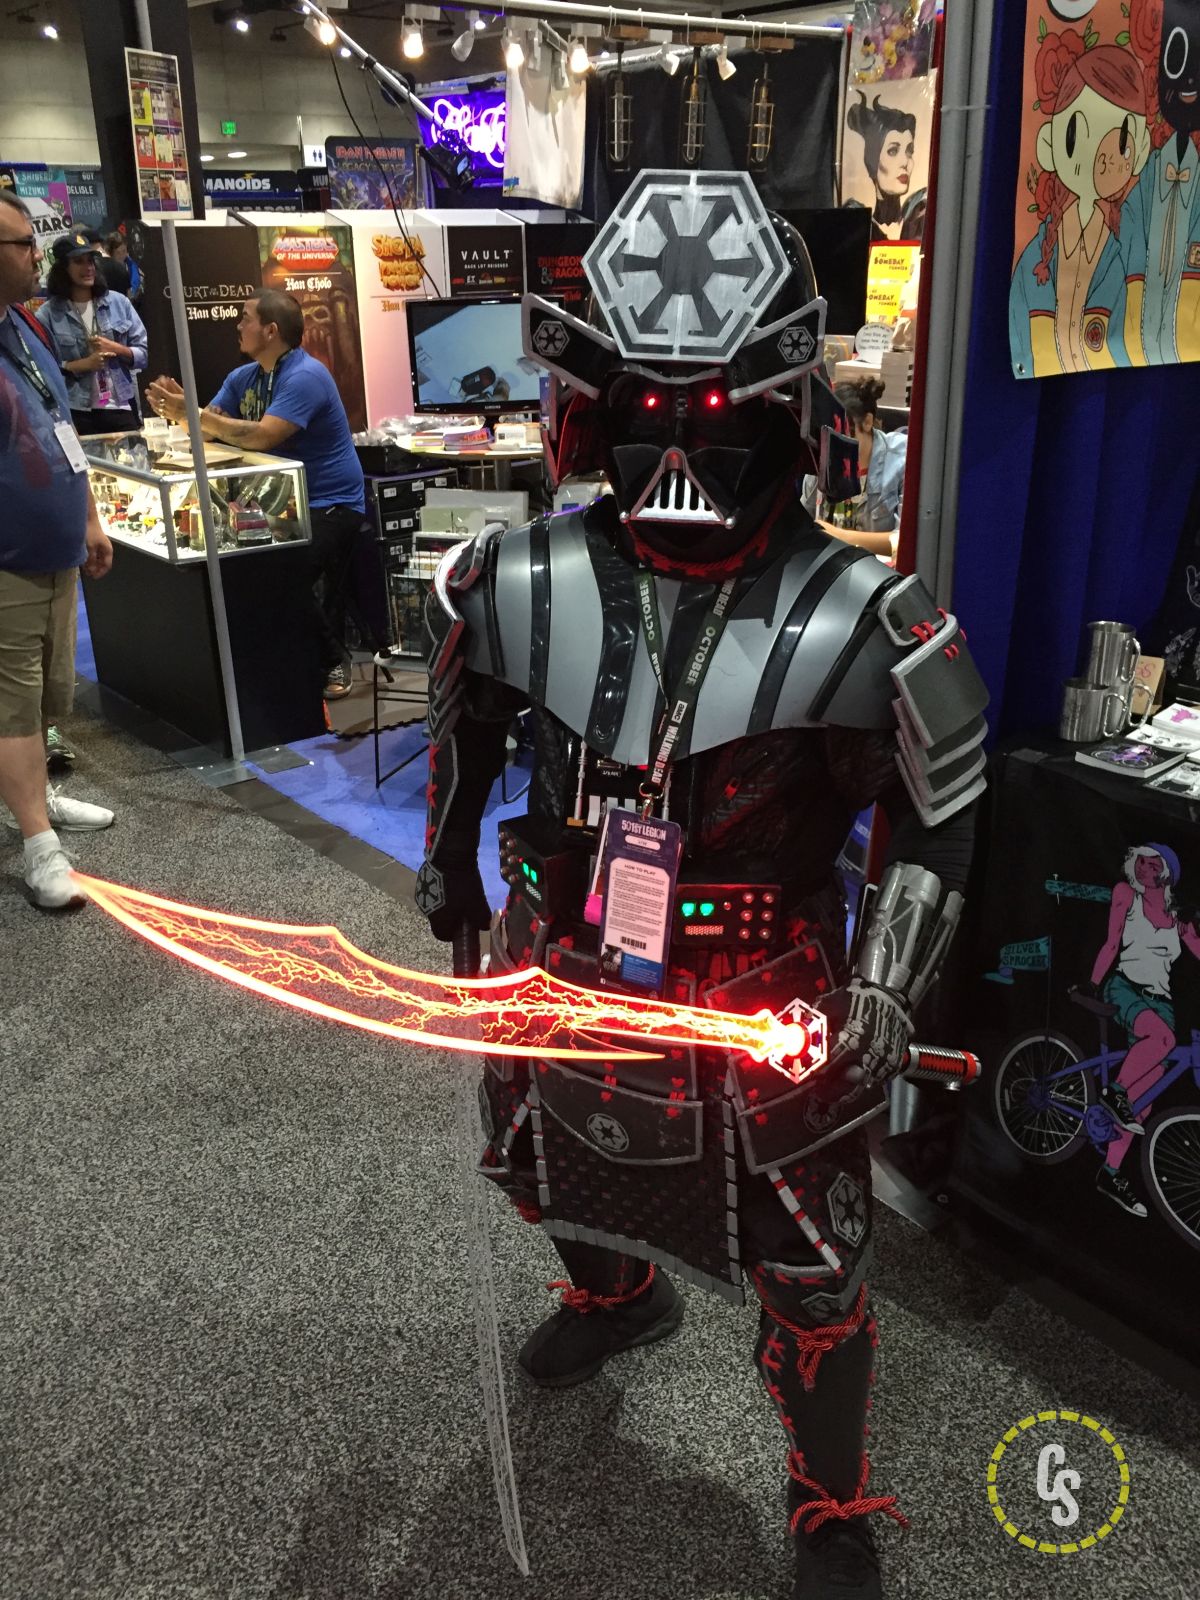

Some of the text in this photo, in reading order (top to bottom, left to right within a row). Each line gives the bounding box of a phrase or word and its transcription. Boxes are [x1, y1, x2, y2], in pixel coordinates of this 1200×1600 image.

[67, 185, 94, 195] DELISLE
[203, 178, 271, 191] MANOIDS
[277, 252, 286, 260] OF
[288, 252, 301, 260] THE
[461, 249, 510, 261] VAULT
[284, 277, 332, 291] Han Cholo
[163, 285, 209, 299] CURT
[187, 304, 239, 321] Han Cholo
[686, 626, 716, 685] OCTOBER
[656, 724, 679, 762] WALKING
[651, 760, 667, 784] DEAD
